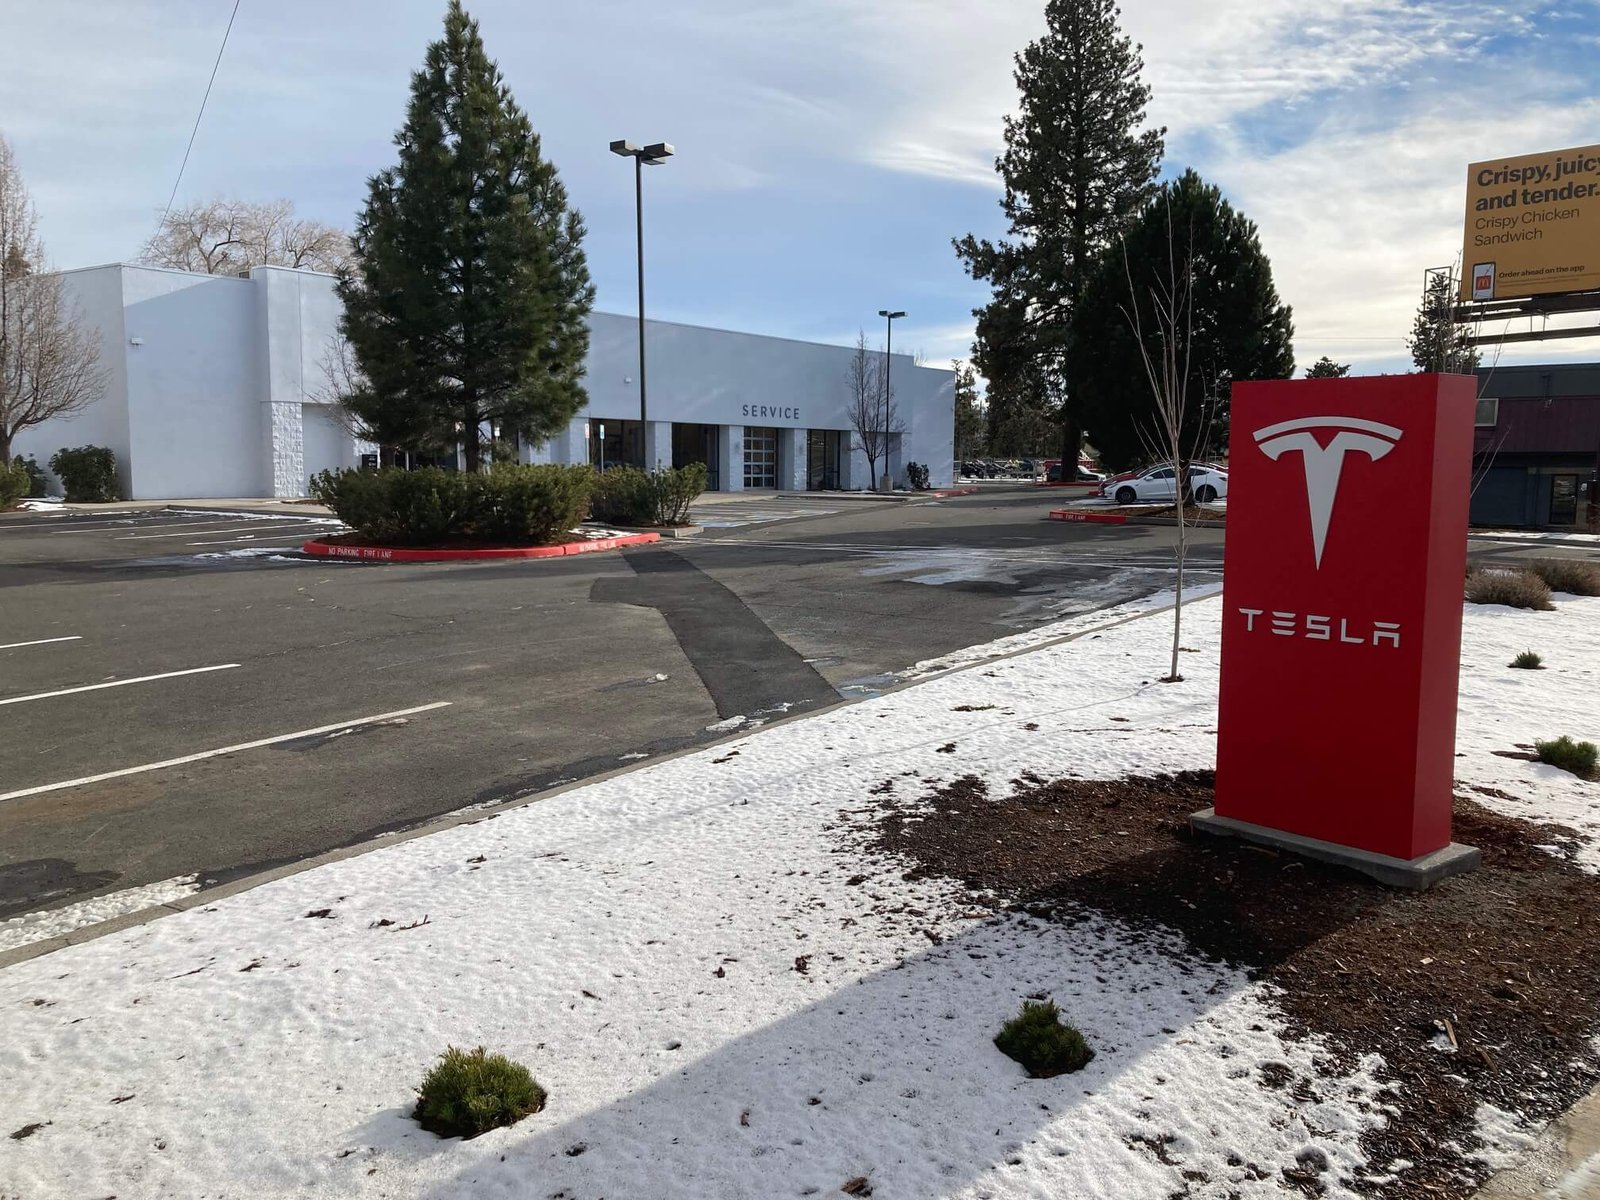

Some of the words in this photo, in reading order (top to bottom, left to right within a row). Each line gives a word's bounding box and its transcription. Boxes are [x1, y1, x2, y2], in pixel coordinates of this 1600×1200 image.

[1477, 165, 1551, 187] Crispy,
[1475, 189, 1517, 211] and
[1521, 182, 1600, 205] tender.
[1475, 215, 1519, 230] Crispy
[1521, 207, 1580, 224] Chicken
[1474, 228, 1543, 247] Sandwich
[1520, 267, 1544, 276] ahead
[1569, 265, 1585, 273] app
[742, 404, 800, 420] SERVICE
[328, 547, 336, 555] NO
[337, 547, 359, 557] PARKING
[363, 549, 376, 558] FIRE
[1238, 607, 1401, 648] TESLA
